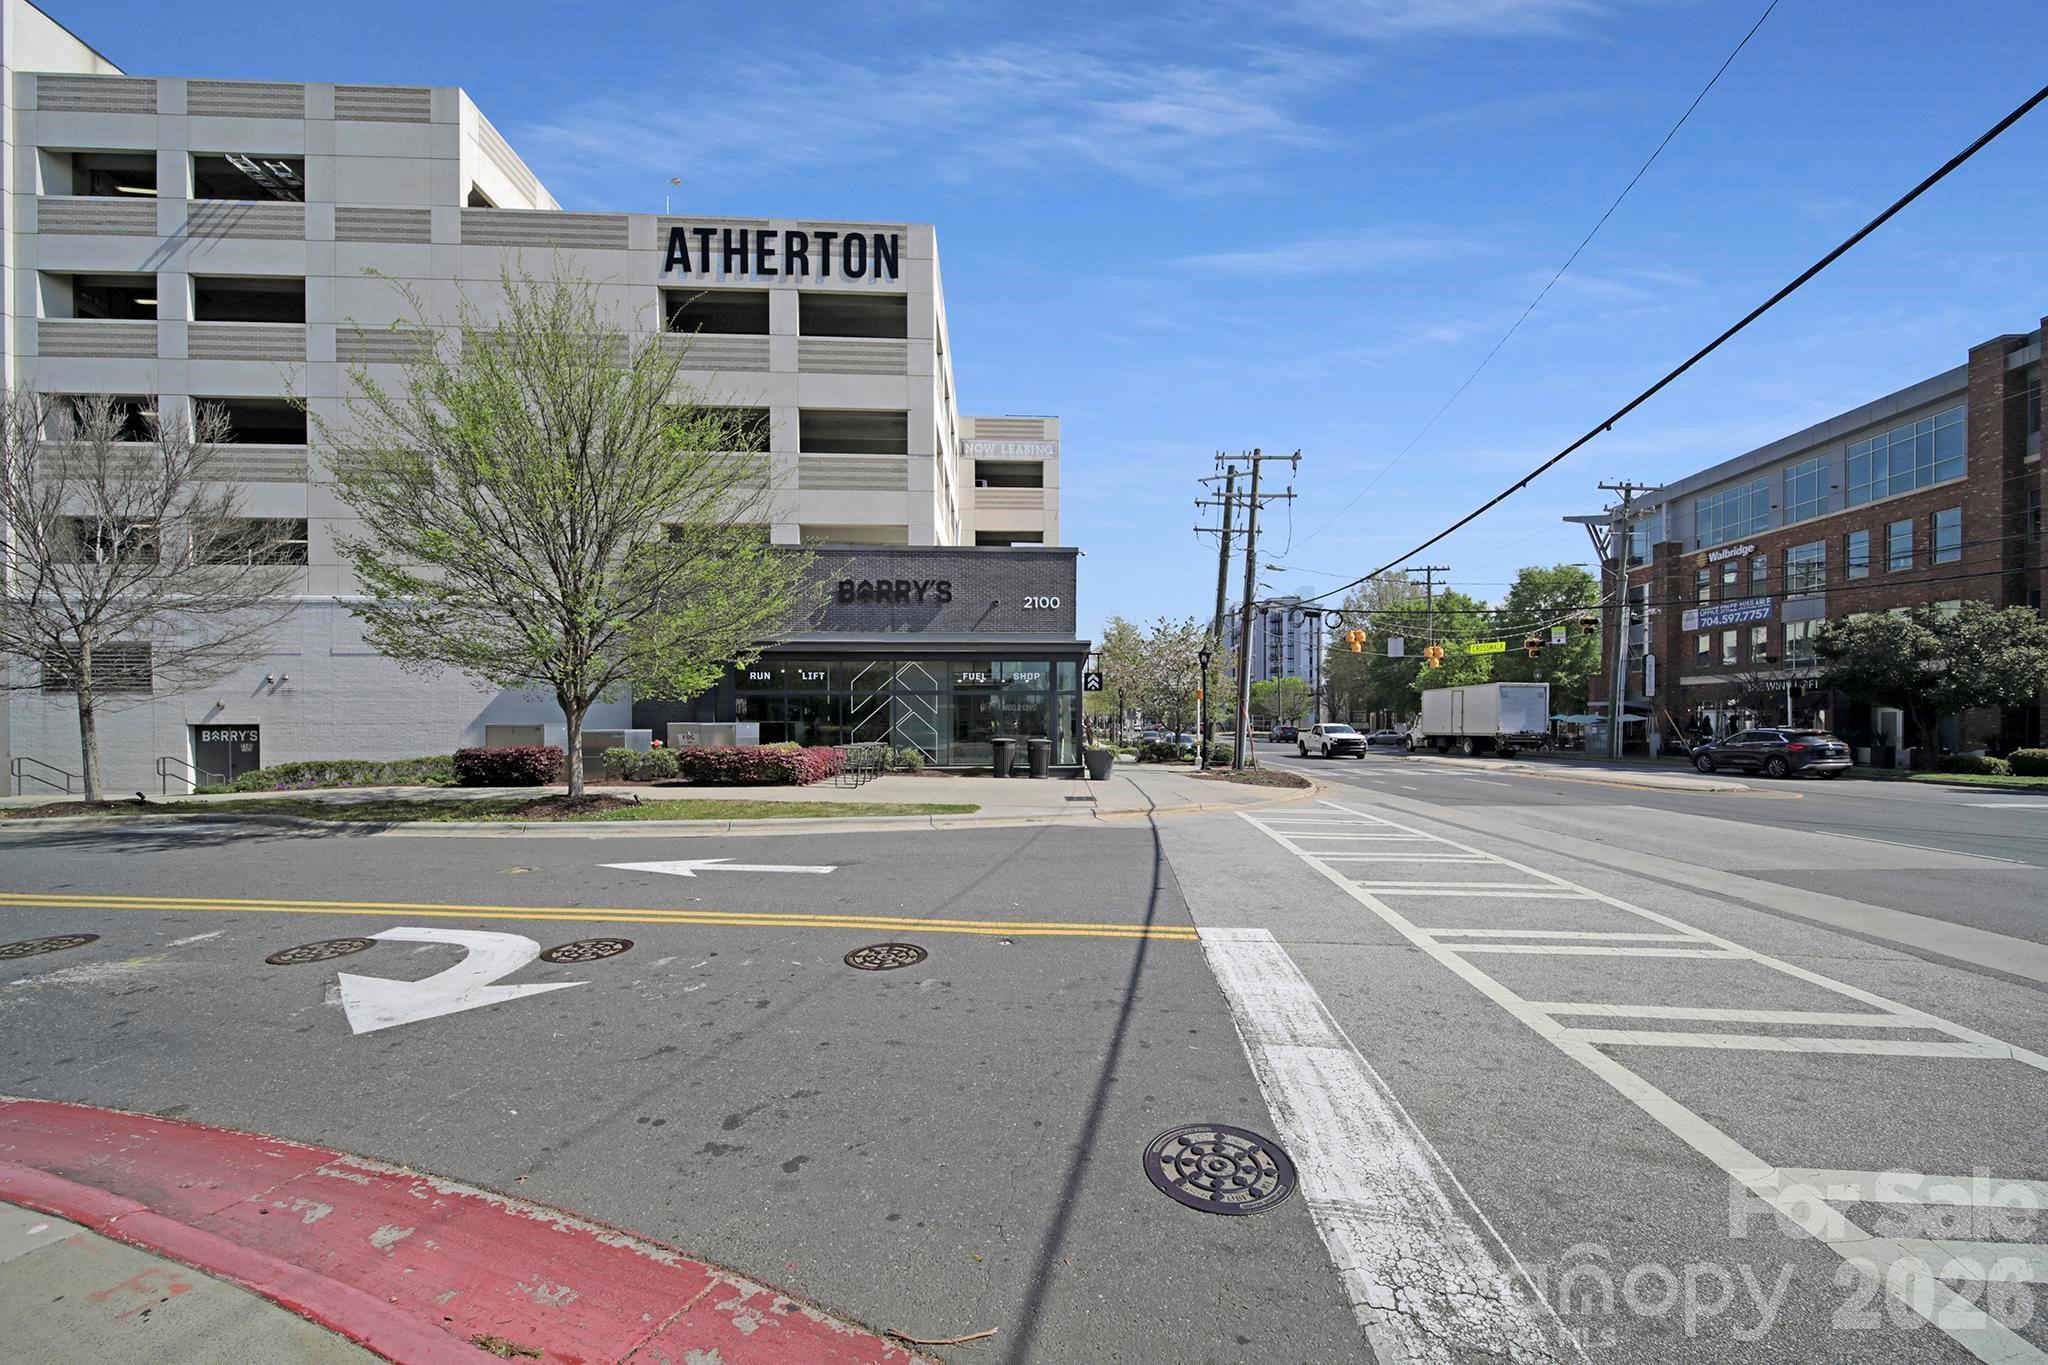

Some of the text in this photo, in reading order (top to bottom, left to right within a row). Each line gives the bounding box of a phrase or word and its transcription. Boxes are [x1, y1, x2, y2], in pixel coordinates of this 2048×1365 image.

[664, 226, 899, 279] ATHERTON
[964, 443, 1054, 455] NOW LEASING
[1709, 545, 1755, 562] Walbridge
[1023, 596, 1061, 609] 2100
[1701, 608, 1769, 627] 704.597.7757
[1472, 643, 1505, 653] CROSSWALK
[749, 671, 771, 680] RUN
[802, 671, 825, 680] LIFT
[962, 672, 987, 680] FUEL
[1013, 672, 1040, 680] SHOP
[1766, 681, 1792, 691] WIN
